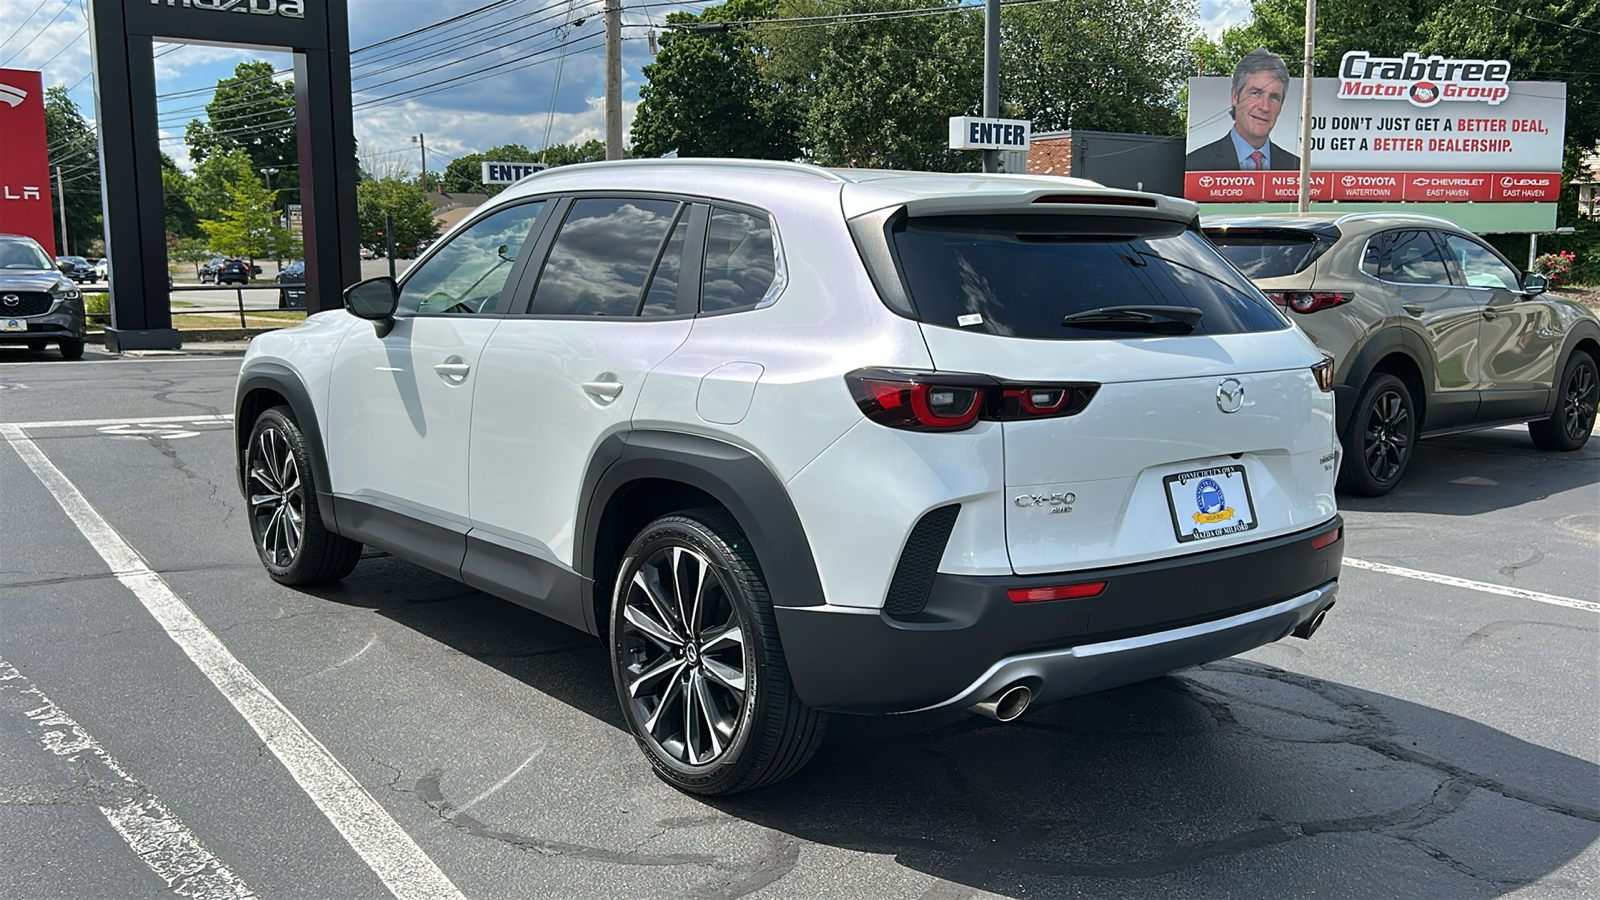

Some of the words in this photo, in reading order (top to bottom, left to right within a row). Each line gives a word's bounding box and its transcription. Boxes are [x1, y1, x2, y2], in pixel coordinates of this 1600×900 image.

[1343, 55, 1508, 82] Crabtree
[1342, 81, 1408, 97] Motor
[1443, 83, 1507, 101] Group
[1301, 117, 1327, 130] OU
[1332, 117, 1373, 131] DON'T
[1377, 117, 1411, 131] JUST
[1415, 118, 1440, 132] GET
[1443, 118, 1453, 132] A
[1457, 118, 1507, 132] BETTER
[1511, 119, 1549, 135] DEAL,
[970, 122, 1025, 146] ENTER
[1299, 138, 1326, 151] OU
[1330, 137, 1356, 151] GET
[1359, 138, 1369, 151] A
[1373, 138, 1423, 151] BETTER
[1428, 138, 1513, 153] DEALERSHIP.
[1215, 177, 1256, 186] TOYOTA
[1357, 176, 1396, 186] TOYOTA
[1431, 178, 1485, 186] CHEVROLET
[1513, 178, 1550, 186] LEXUS
[1210, 188, 1243, 197] MILFORD
[1345, 188, 1391, 197] WATERTOWN
[1426, 189, 1447, 197] EAST
[1449, 189, 1469, 197] HAVEN
[1503, 189, 1522, 197] EAST
[1524, 189, 1545, 197] HAVEN
[1222, 466, 1235, 474] OWN
[1014, 492, 1076, 508] CX-50
[1193, 530, 1214, 540] MAZDA
[1215, 529, 1223, 537] OF
[1224, 524, 1249, 535] MILFORD
